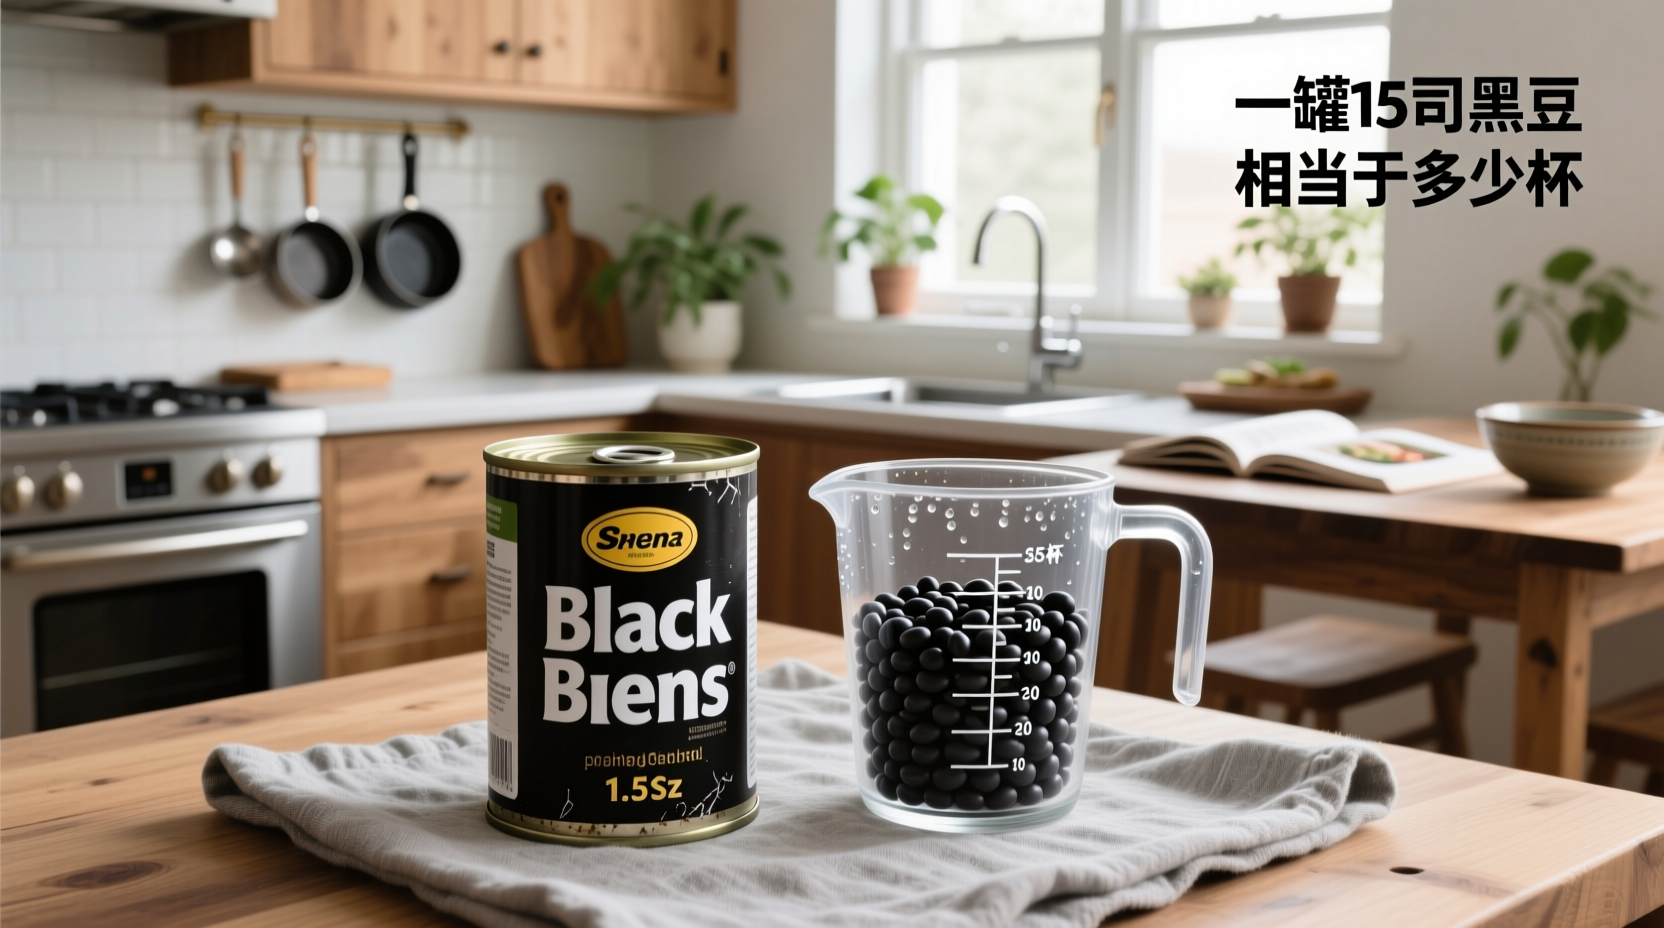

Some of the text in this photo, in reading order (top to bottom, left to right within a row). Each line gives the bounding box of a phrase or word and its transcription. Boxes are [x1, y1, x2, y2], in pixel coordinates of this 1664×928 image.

[545, 578, 732, 654] Black
[1021, 685, 1040, 700] 20
[1014, 721, 1032, 736] 20
[1012, 757, 1025, 772] 10
